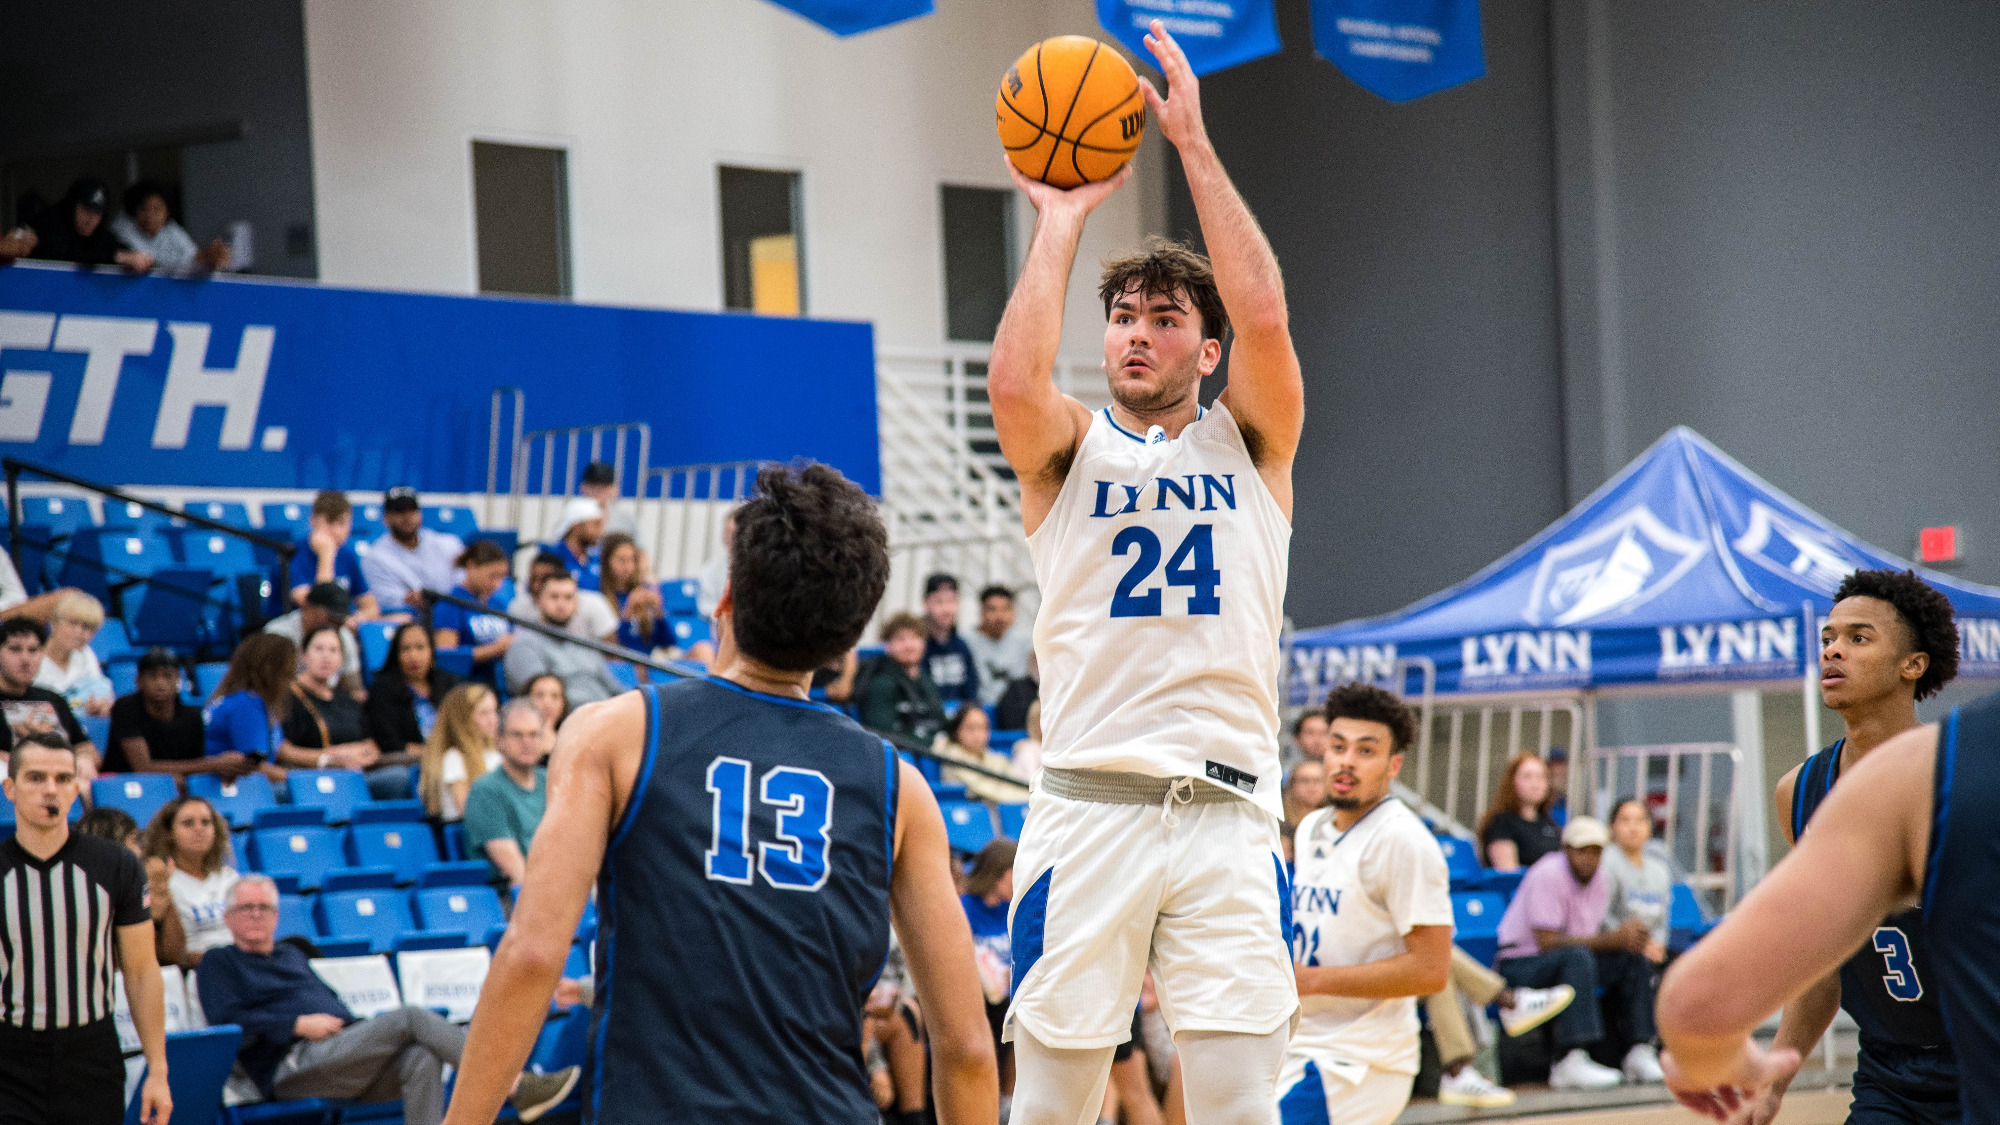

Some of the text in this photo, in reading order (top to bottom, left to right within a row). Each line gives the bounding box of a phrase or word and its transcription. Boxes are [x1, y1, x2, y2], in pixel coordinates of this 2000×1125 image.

[1089, 474, 1237, 518] LYNN
[1110, 524, 1221, 618] 24
[1292, 643, 1397, 684] YNN
[1461, 630, 1592, 677] LYNN
[1660, 617, 1798, 668] LYNN
[705, 755, 835, 893] 13
[1293, 884, 1342, 915] YNN
[1872, 926, 1924, 1002] 3
